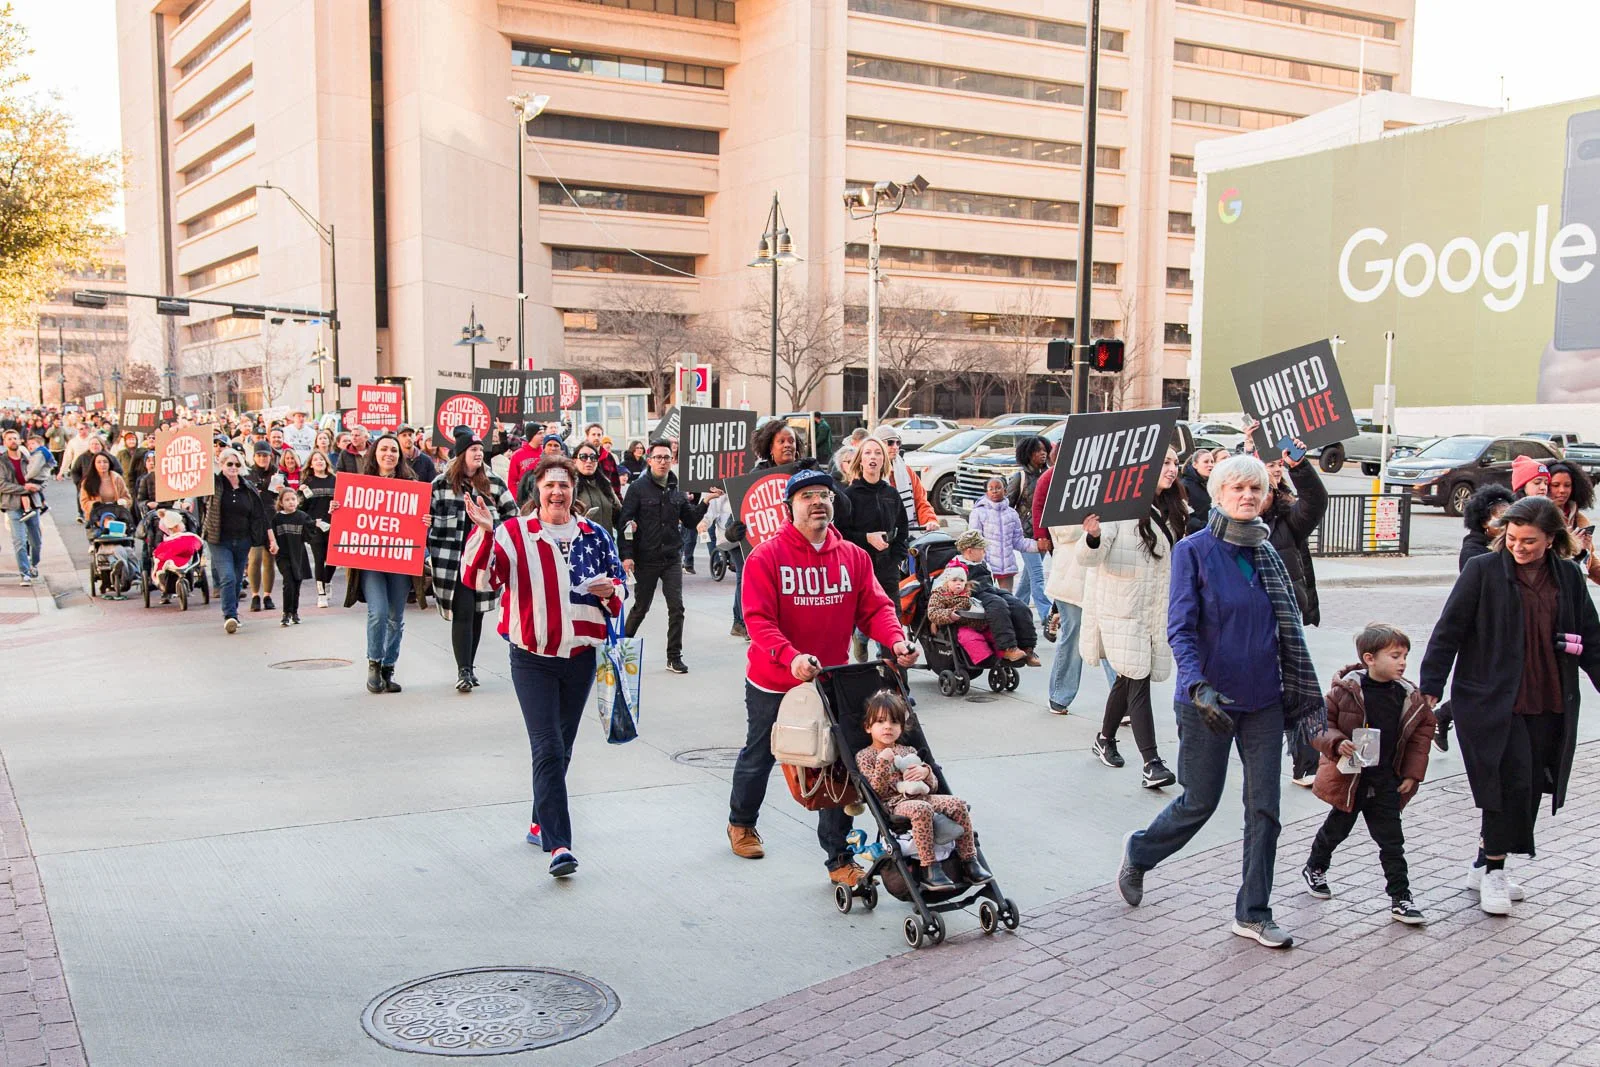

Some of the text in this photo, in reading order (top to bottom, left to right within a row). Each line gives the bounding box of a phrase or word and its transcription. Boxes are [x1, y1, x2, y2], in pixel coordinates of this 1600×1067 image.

[1217, 187, 1243, 224] G
[1338, 204, 1597, 313] Google
[361, 390, 397, 404] ADOPTION
[480, 377, 520, 397] UNIFIED
[524, 377, 555, 398] NIFIED
[1249, 355, 1329, 417] UNIFIED
[125, 399, 157, 413] UNIFIED
[368, 403, 389, 412] OVER
[446, 397, 484, 415] CITIZENS
[498, 396, 519, 414] LIFE
[536, 396, 555, 413] LIFE
[123, 413, 138, 427] FOR
[361, 412, 397, 426] ABORTION
[440, 411, 488, 430] FOR LIFE
[1261, 389, 1340, 449] FOR LIFE
[166, 435, 202, 457] CITIZENS
[689, 420, 747, 454] UNIFIED
[1069, 423, 1161, 476] UNIFIED
[161, 451, 207, 476] FOR LIFE
[688, 451, 747, 481] FOR LIFE
[167, 470, 201, 492] MARCH
[1059, 464, 1150, 512] FOR LIFE
[343, 486, 419, 516] ADOPTION
[748, 478, 787, 511] CITIZE
[356, 513, 401, 533] OVER
[744, 507, 781, 538] FOR
[337, 530, 415, 561] ABORTION
[780, 564, 853, 596] BIOLA
[793, 594, 845, 606] UNIVERSITY
